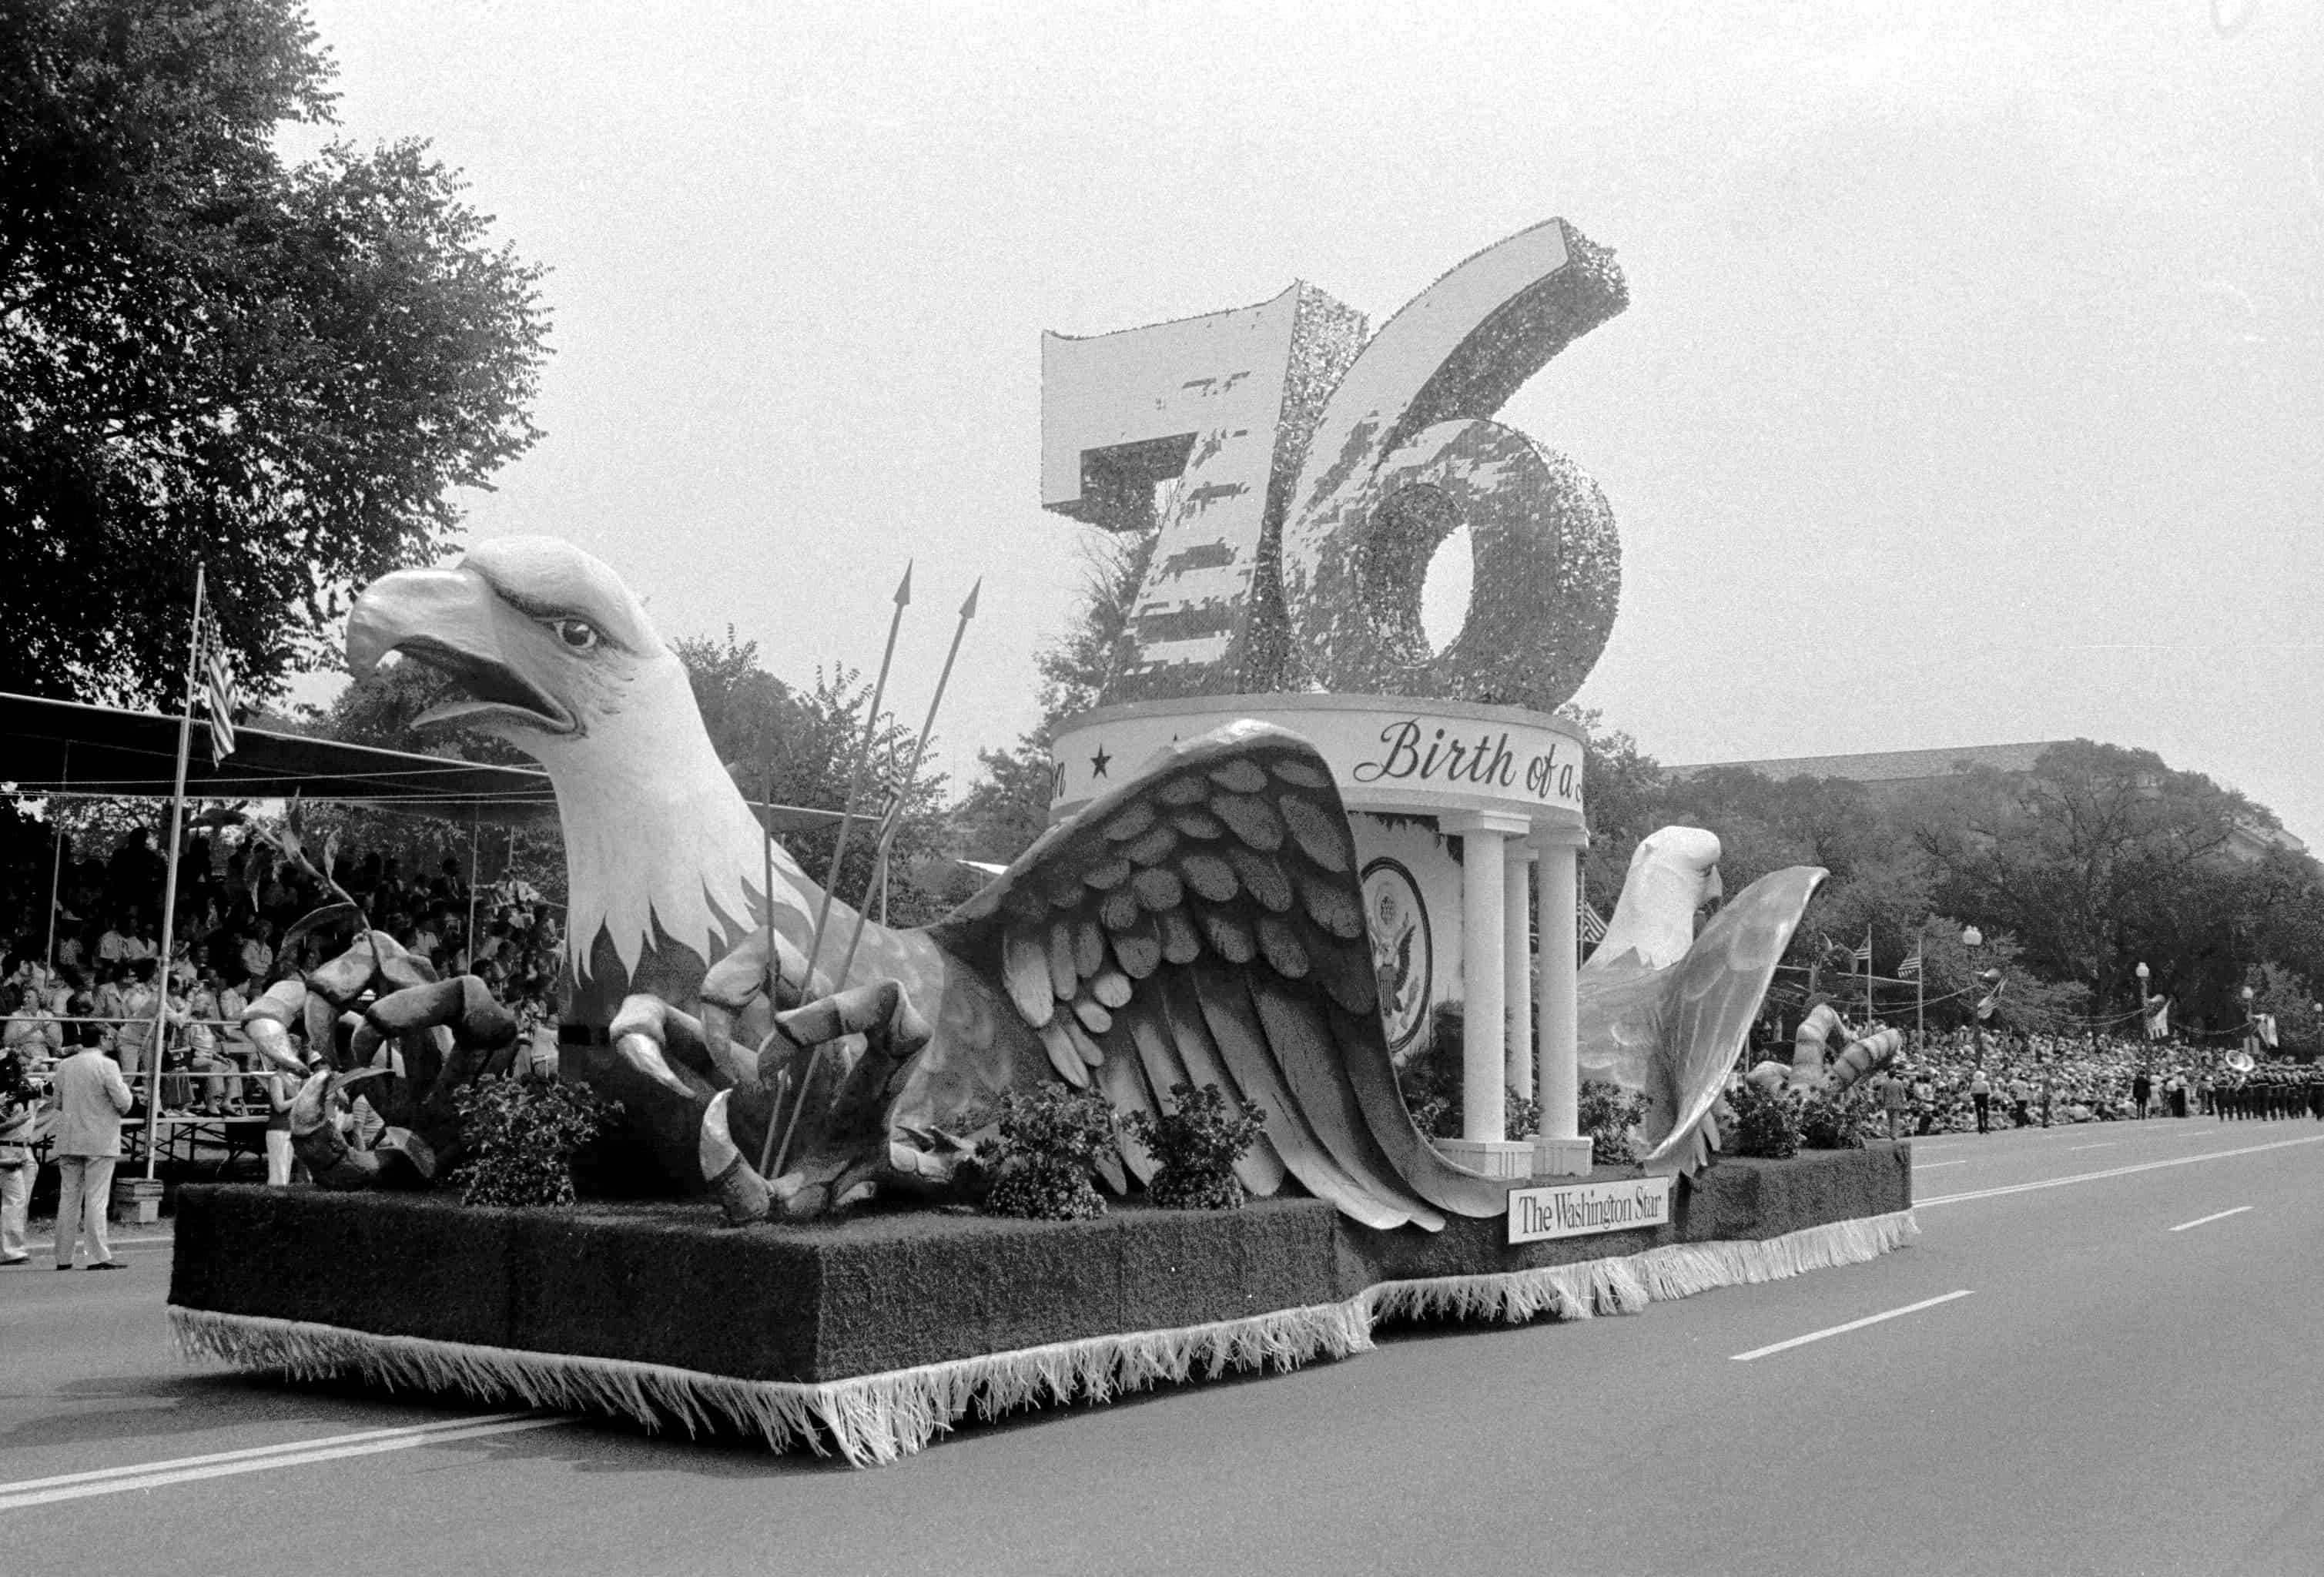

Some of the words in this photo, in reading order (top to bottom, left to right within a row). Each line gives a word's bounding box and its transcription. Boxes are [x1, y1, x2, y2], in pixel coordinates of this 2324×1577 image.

[1041, 217, 1630, 710] 76
[1352, 715, 1517, 788] Birth
[1526, 743, 1559, 799] of
[1559, 763, 1573, 799] a
[1518, 1195, 1553, 1234] The
[1554, 1189, 1632, 1230] Washington
[1635, 1185, 1662, 1220] Star
